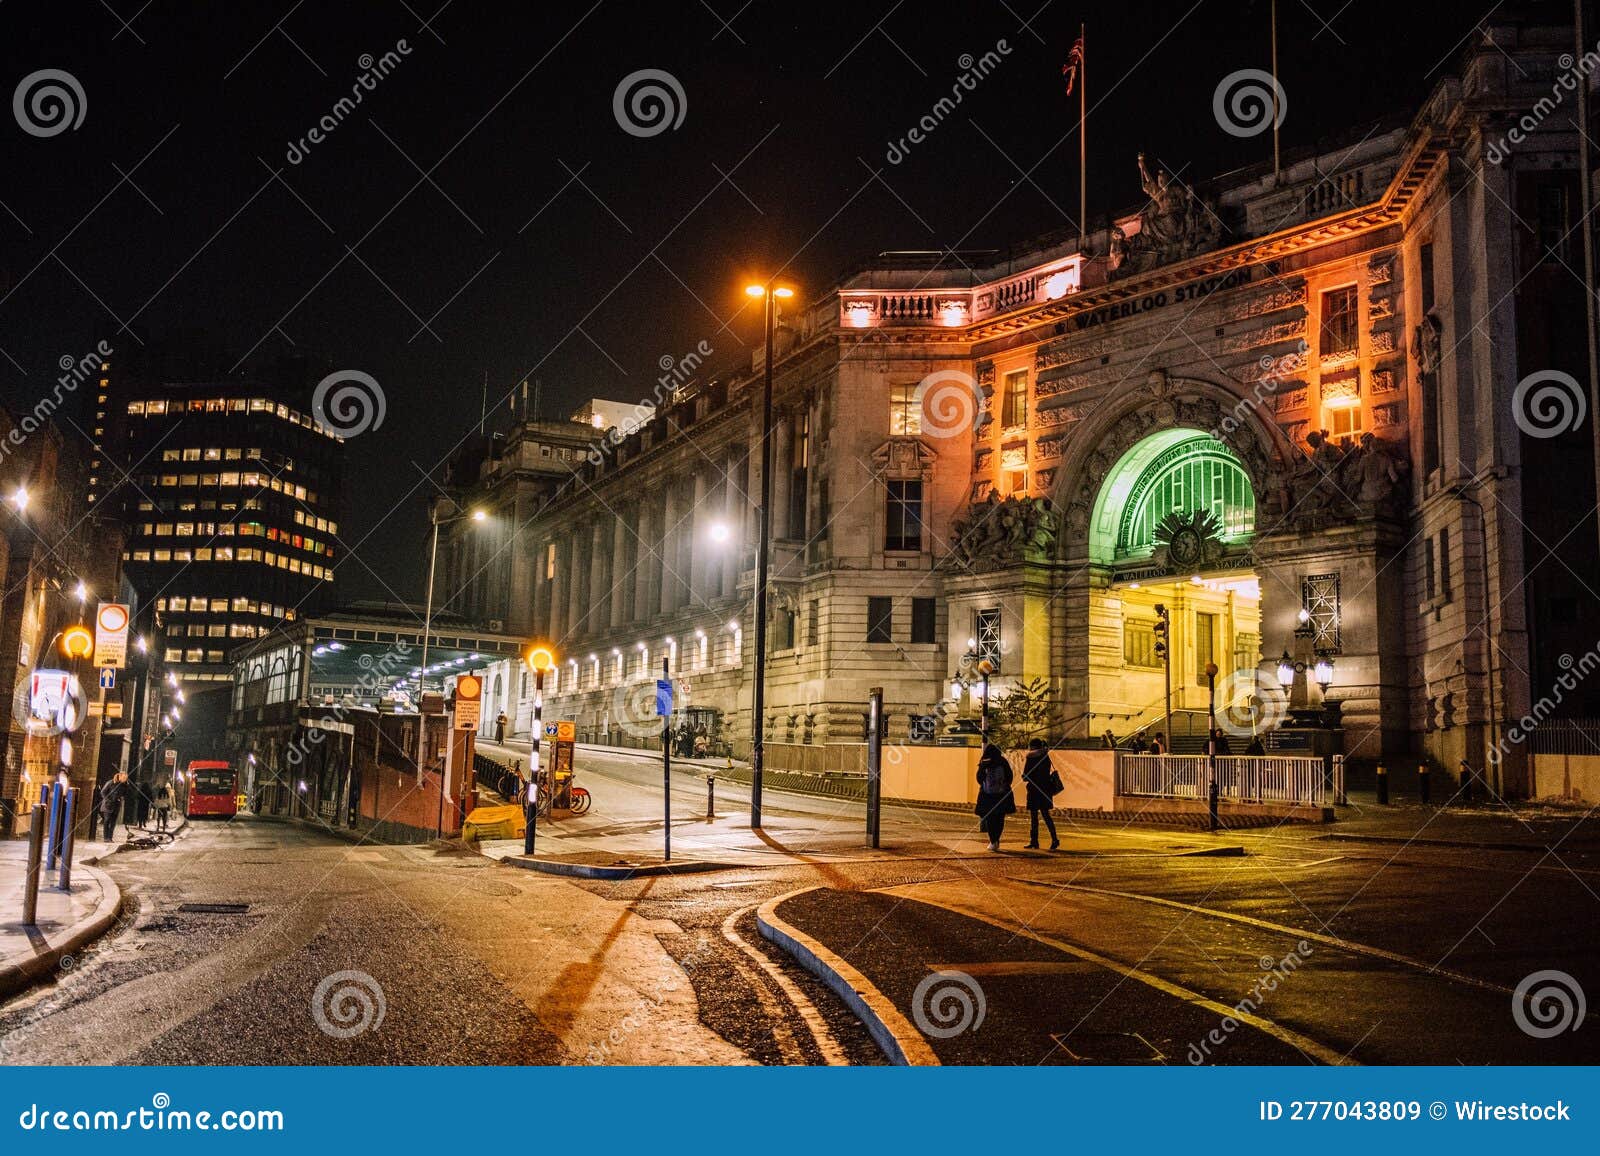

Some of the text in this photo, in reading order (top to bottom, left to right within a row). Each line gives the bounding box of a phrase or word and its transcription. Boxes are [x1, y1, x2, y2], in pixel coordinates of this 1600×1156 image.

[1075, 270, 1251, 328] WATERLOO STATION
[1123, 558, 1251, 581] WATERLOO STATION
